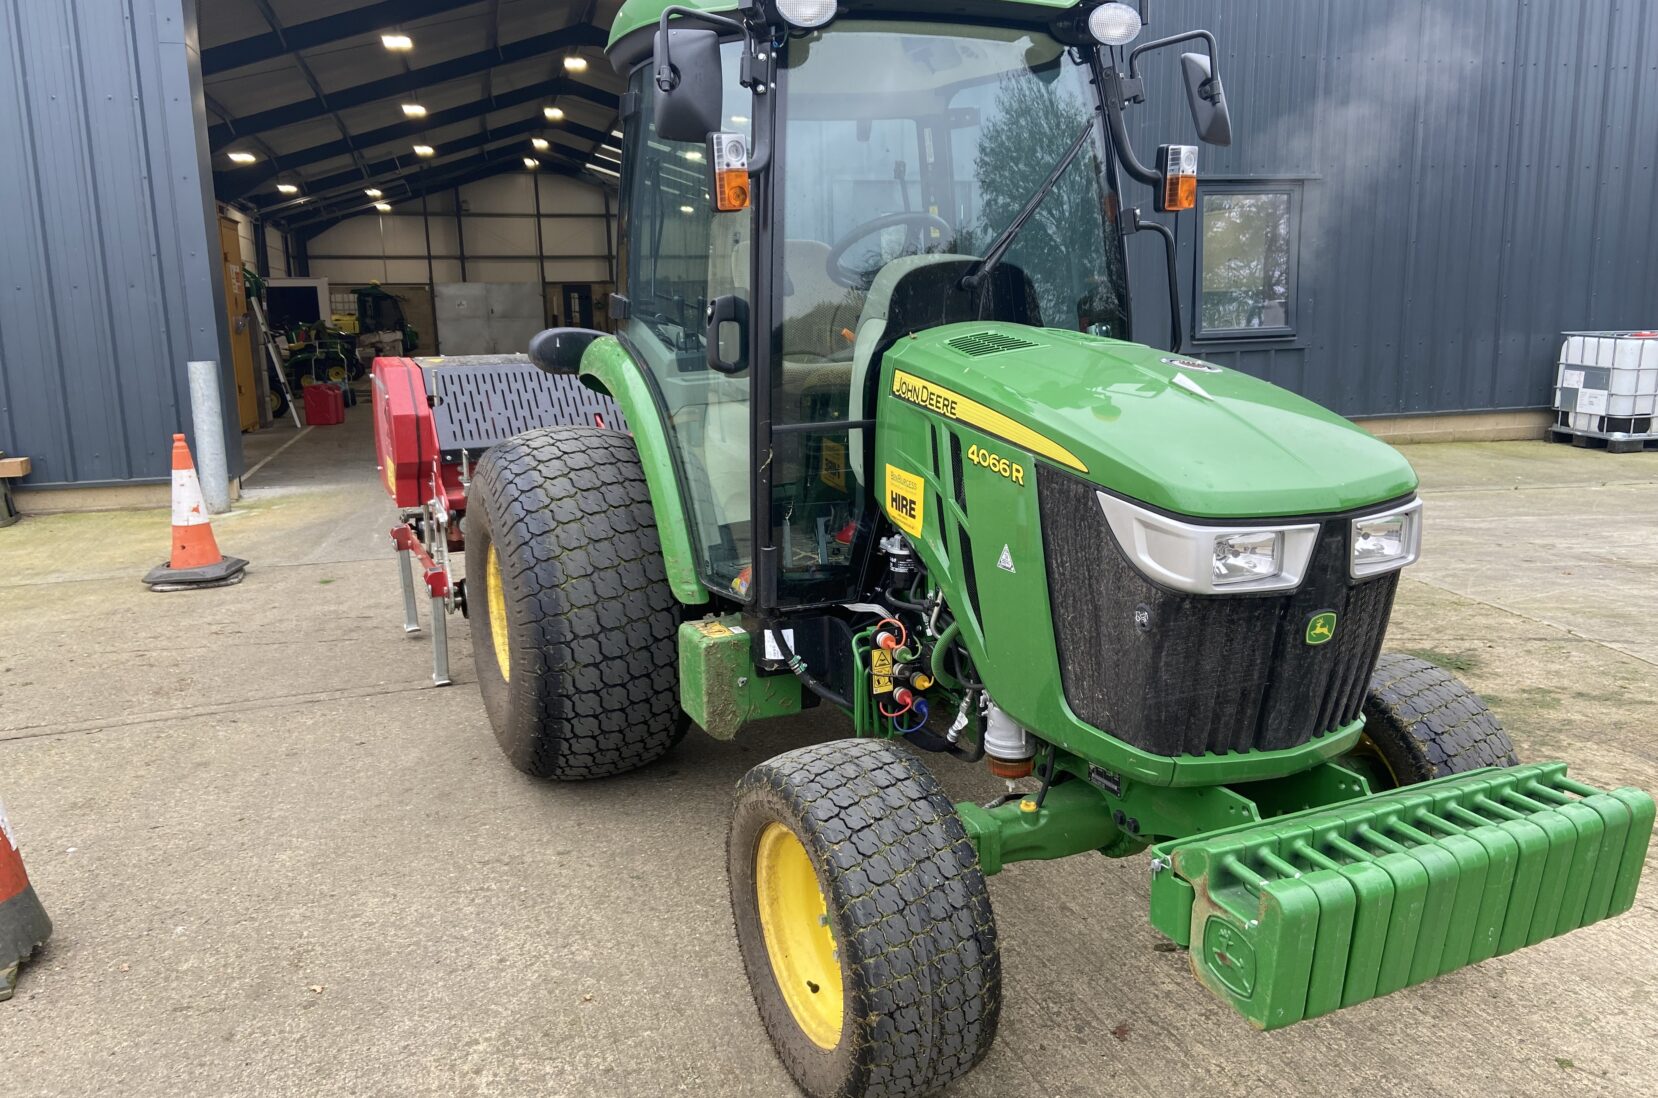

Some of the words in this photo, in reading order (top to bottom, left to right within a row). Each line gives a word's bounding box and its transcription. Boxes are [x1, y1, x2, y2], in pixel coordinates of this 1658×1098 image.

[896, 376, 920, 402] JOHN
[921, 385, 957, 416] DEERE
[890, 489, 917, 520] HIRE
